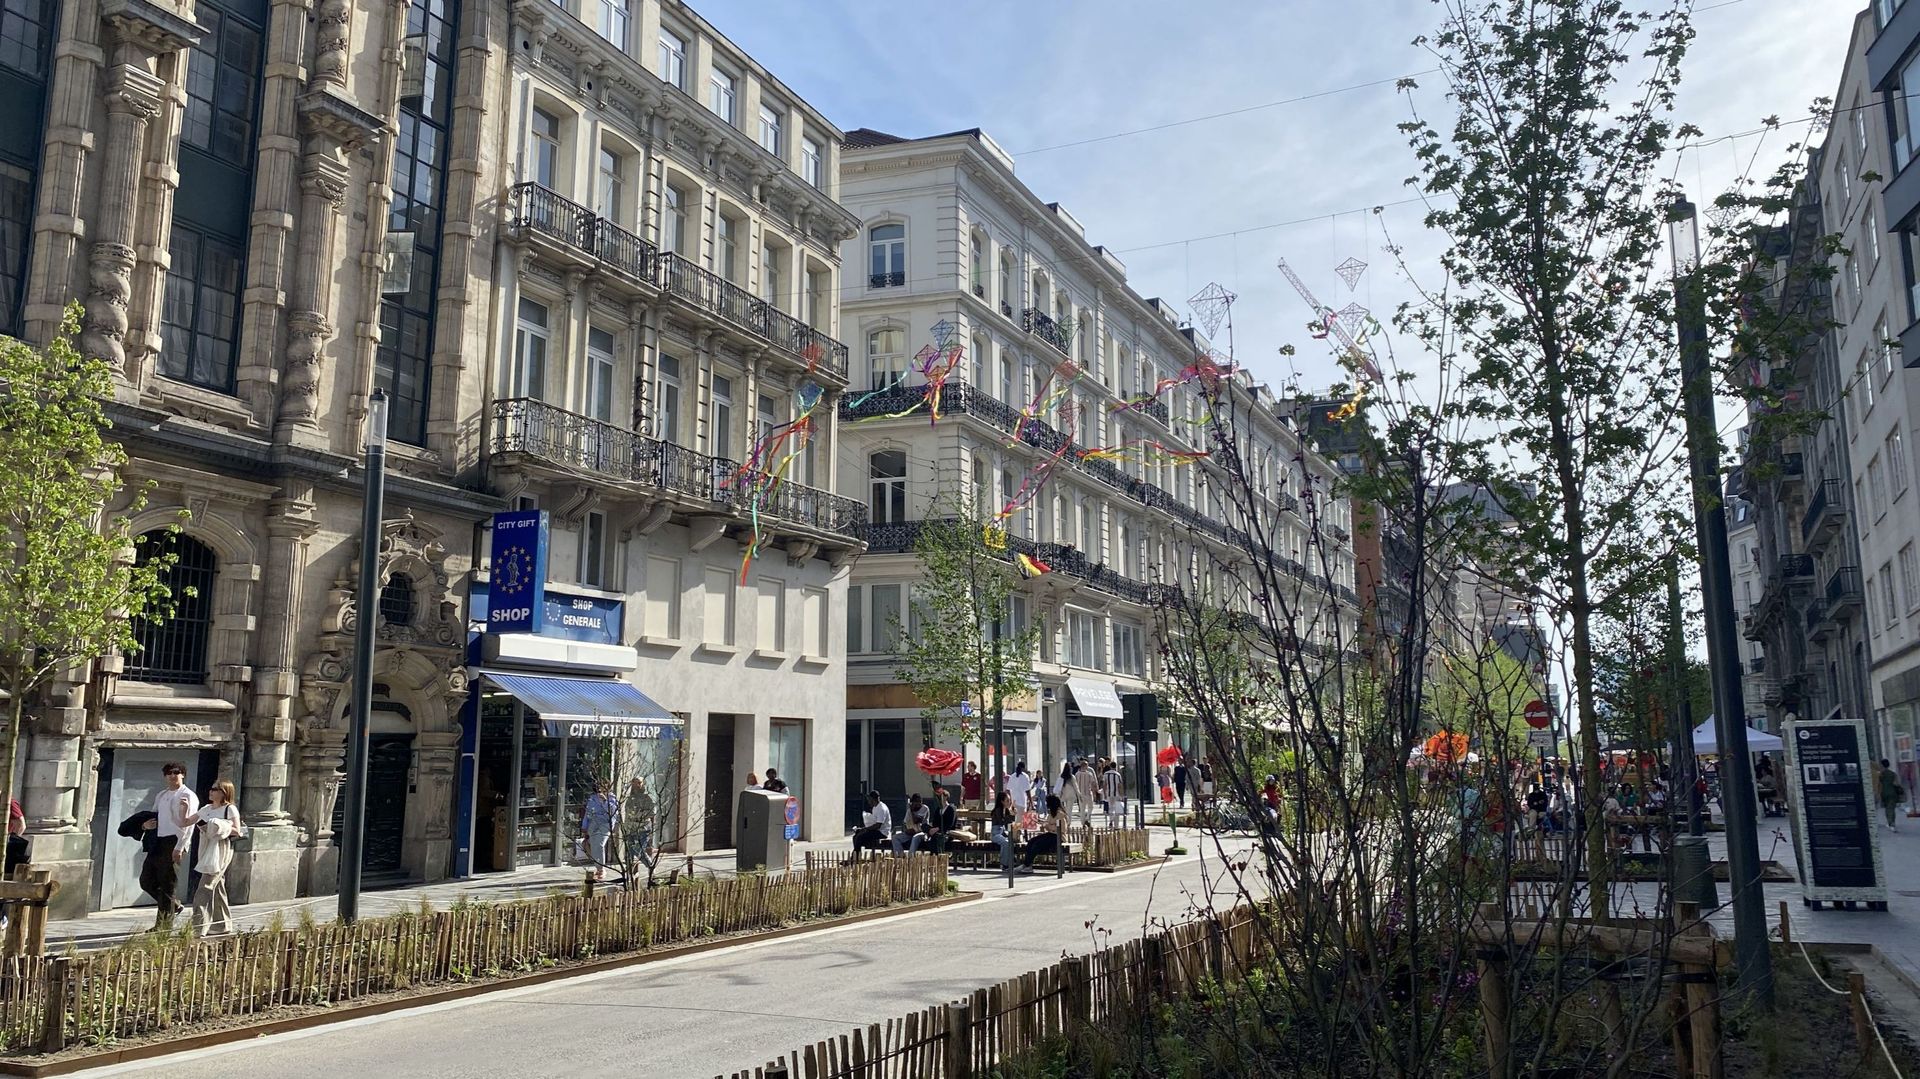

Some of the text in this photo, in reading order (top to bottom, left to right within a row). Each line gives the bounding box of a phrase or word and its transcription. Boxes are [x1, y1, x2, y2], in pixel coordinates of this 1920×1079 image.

[497, 519, 536, 529] CITY GIFT
[572, 599, 593, 610] SHOP
[491, 608, 530, 622] SHOP
[563, 614, 601, 629] GENERALE
[569, 723, 660, 738] CITY GIFT SHOP
